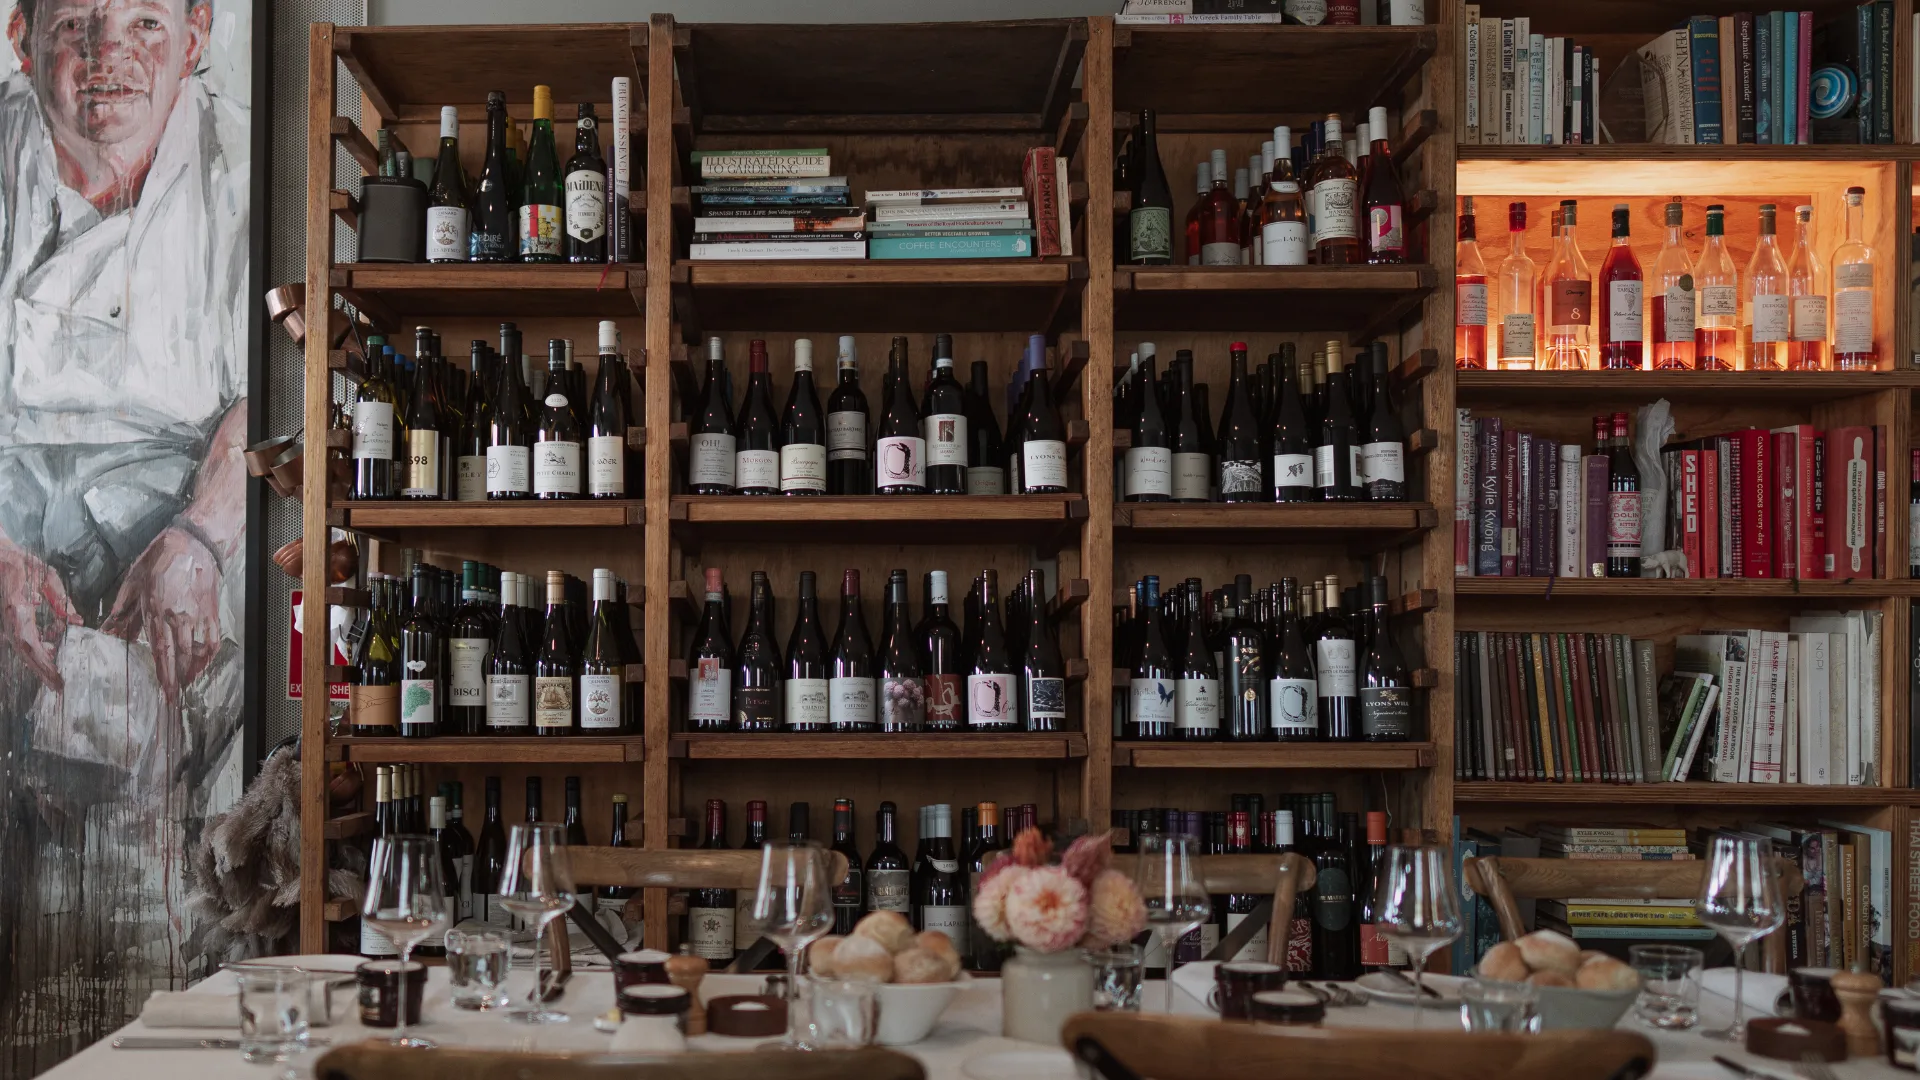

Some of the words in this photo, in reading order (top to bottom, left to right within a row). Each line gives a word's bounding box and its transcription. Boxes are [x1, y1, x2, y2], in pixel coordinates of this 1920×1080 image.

[1469, 30, 1478, 58] Colette's
[1675, 31, 1689, 68] PEPIN
[1741, 20, 1751, 59] Stephanie
[1757, 28, 1769, 59] MAGGIE'S
[1469, 59, 1478, 82] France
[1743, 61, 1753, 102] Alexander
[618, 81, 628, 123] FRENCH
[1504, 92, 1512, 111] Anthony
[1679, 107, 1687, 132] HOME
[618, 128, 628, 175] ESSENCE
[706, 156, 785, 166] ILLUSTRATED
[787, 155, 825, 166] GUIDE
[754, 149, 781, 157] Country
[708, 165, 725, 176] TO
[731, 164, 799, 176] GARDENING
[1042, 177, 1053, 216] FRANCE
[942, 220, 956, 228] Royal
[985, 219, 1004, 227] Society
[899, 240, 935, 250] COFFEE
[939, 239, 1002, 249] ENCOUNTERS
[1570, 307, 1581, 320] 8
[1490, 435, 1498, 447] MY
[1507, 443, 1517, 452] A
[791, 458, 819, 467] Bourgogne
[1461, 431, 1471, 486] preserves
[1490, 448, 1498, 471] CHINA
[1537, 444, 1545, 471] stephanie
[1815, 446, 1823, 477] LOVE
[1504, 454, 1516, 498] homegrown
[1877, 470, 1886, 490] MAHA
[1482, 475, 1497, 505] Kylie
[1685, 454, 1697, 532] SHED
[1815, 481, 1823, 511] MEAT
[1506, 500, 1517, 520] table
[1755, 509, 1763, 530] every
[1481, 509, 1497, 552] Kwong
[1756, 532, 1764, 545] day
[1772, 641, 1780, 672] CLASSIC
[1815, 641, 1825, 671] NOPI
[1726, 665, 1734, 683] HUGH
[290, 683, 350, 695] EXISHE
[1770, 673, 1778, 703] FRENCH
[1645, 698, 1653, 722] BAKING
[1722, 684, 1733, 762] FEARNLEY-WHITTINGSTALL
[1732, 697, 1740, 724] COTTAGE
[1768, 705, 1776, 737] RECIPES
[1909, 819, 1920, 847] THAI
[1909, 850, 1920, 900] STREET
[1571, 911, 1591, 919] RIVER
[1846, 897, 1852, 906] OF
[1861, 884, 1870, 923] COOKERY
[1908, 902, 1920, 939] FOOD
[1861, 924, 1869, 948] BOOK
